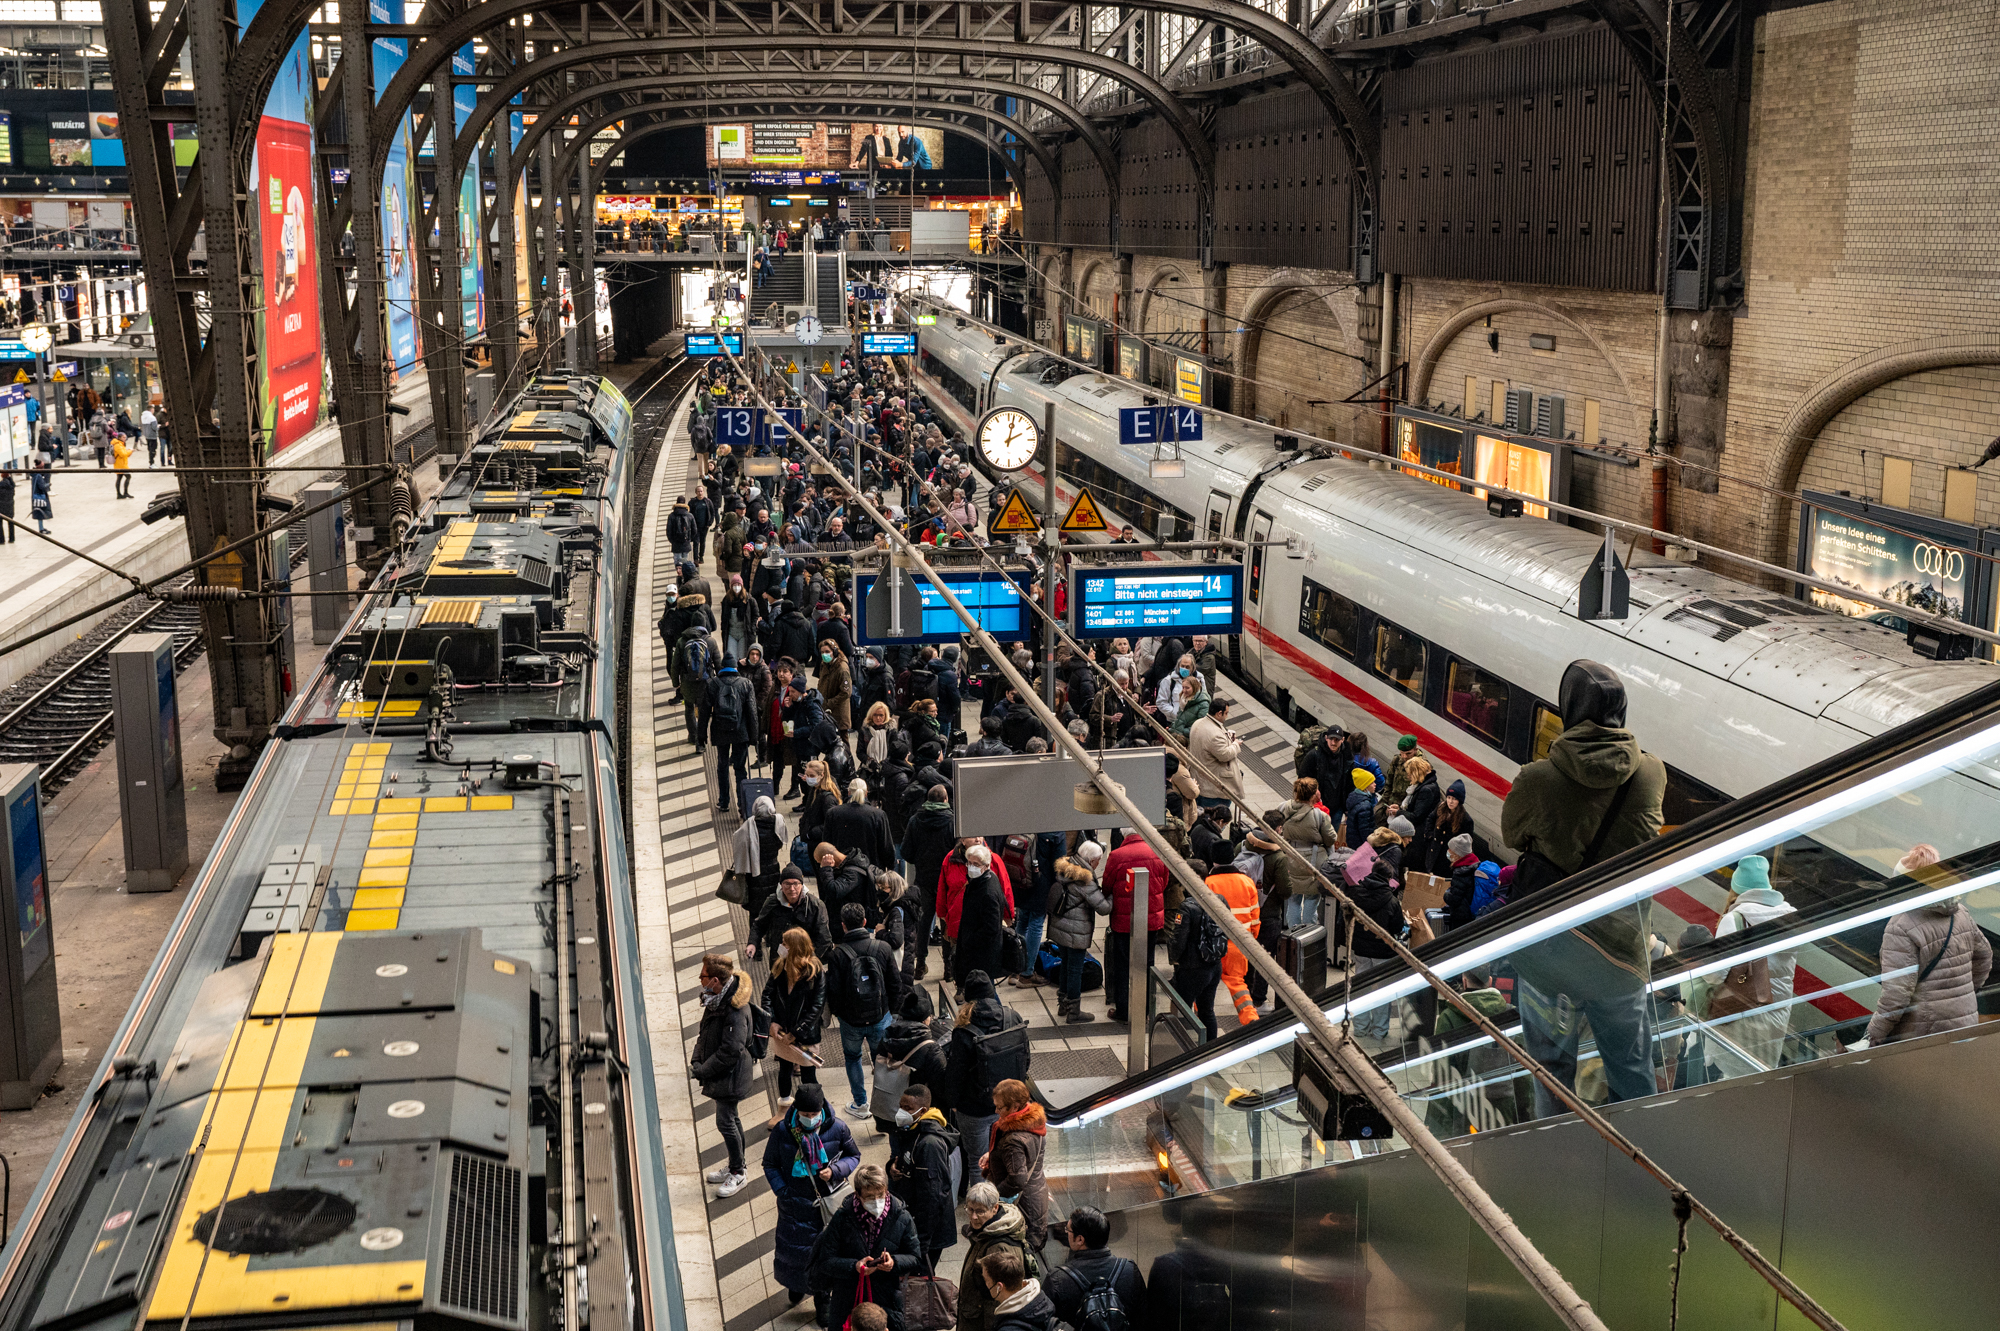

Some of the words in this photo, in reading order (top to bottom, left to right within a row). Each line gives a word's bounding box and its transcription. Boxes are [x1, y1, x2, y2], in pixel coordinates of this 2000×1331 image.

[52, 120, 85, 129] VIELFÄLTIG
[838, 198, 846, 207] 14
[60, 288, 69, 299] D
[858, 287, 866, 298] D
[722, 411, 751, 436] 13
[771, 412, 787, 438] E
[1134, 411, 1151, 437] E
[1170, 408, 1197, 433] 14
[1822, 520, 1847, 534] Unsere
[1848, 527, 1864, 539] Idee
[1866, 532, 1886, 545] eines
[1820, 535, 1856, 550] perfekten
[1858, 543, 1898, 562] Schlittens.
[1204, 576, 1221, 592] 14
[1115, 590, 1135, 599] Bitte
[1138, 589, 1158, 599] nicht
[1161, 589, 1203, 599] einsteigen
[1304, 586, 1311, 607] 2
